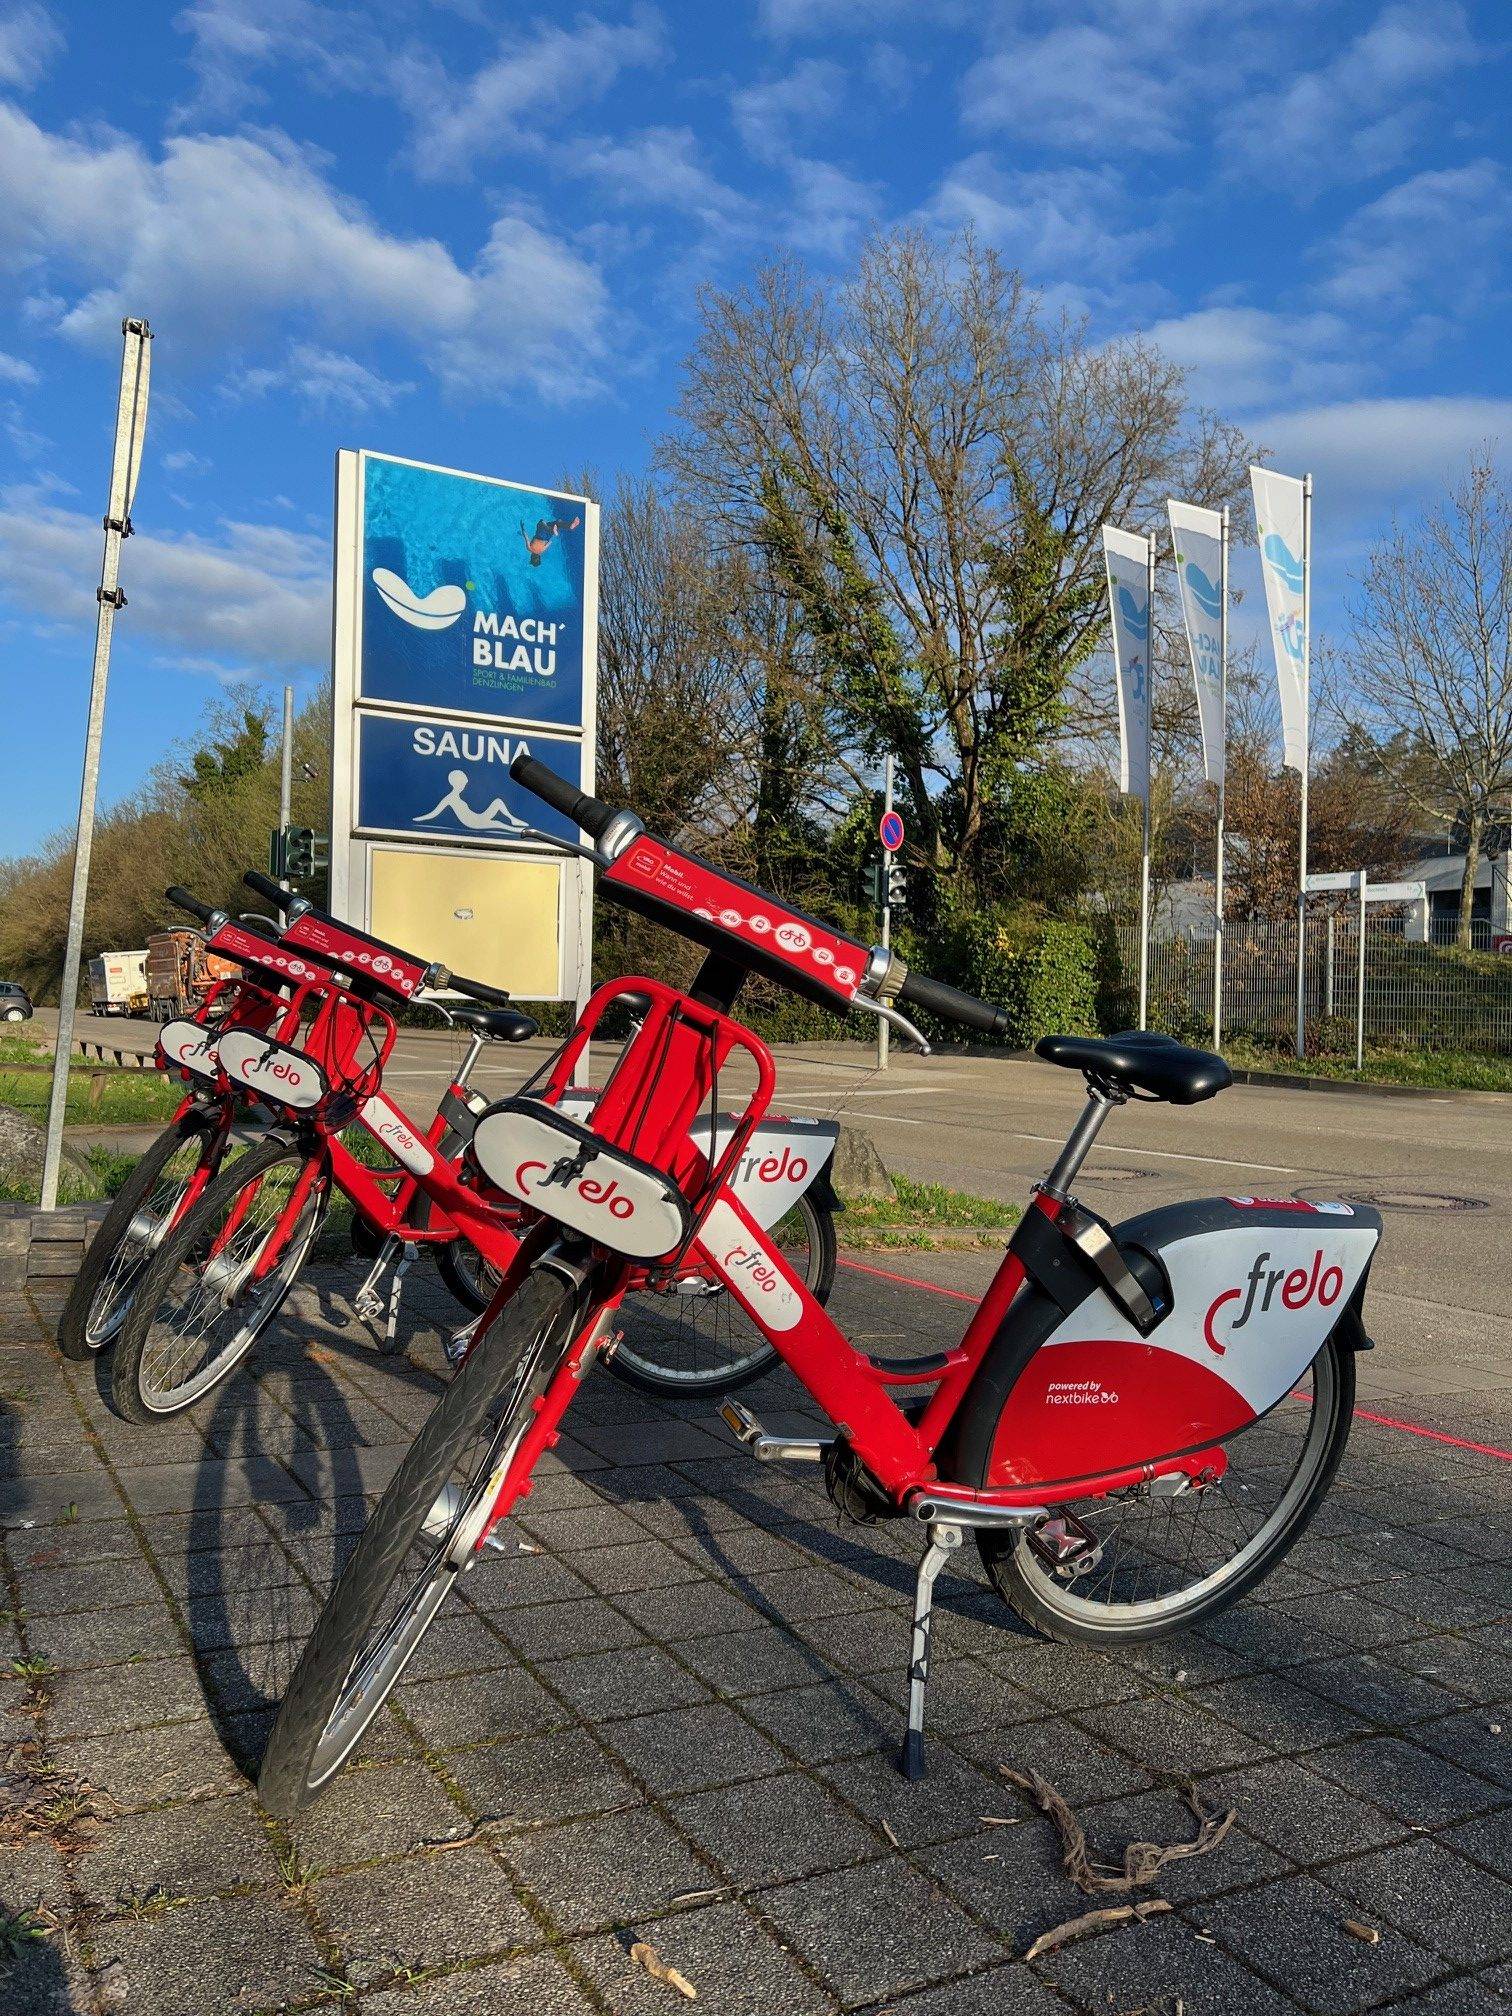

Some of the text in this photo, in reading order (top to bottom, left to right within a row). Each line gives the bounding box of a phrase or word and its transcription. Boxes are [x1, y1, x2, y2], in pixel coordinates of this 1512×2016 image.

[473, 637, 556, 676] BLAU
[472, 668, 557, 689] SPORT & FAMILIENBAD
[472, 677, 524, 692] DENZLINGEN
[412, 727, 532, 766] SAUNA
[656, 876, 668, 888] wie
[667, 883, 676, 891] du
[659, 870, 692, 891] Wann und
[188, 1041, 219, 1062] fre
[386, 1124, 414, 1150] frelo
[734, 1250, 777, 1293] frelo
[1232, 1249, 1344, 1329] frelo
[1048, 1380, 1102, 1392] powered by
[1046, 1391, 1100, 1405] nextbike
